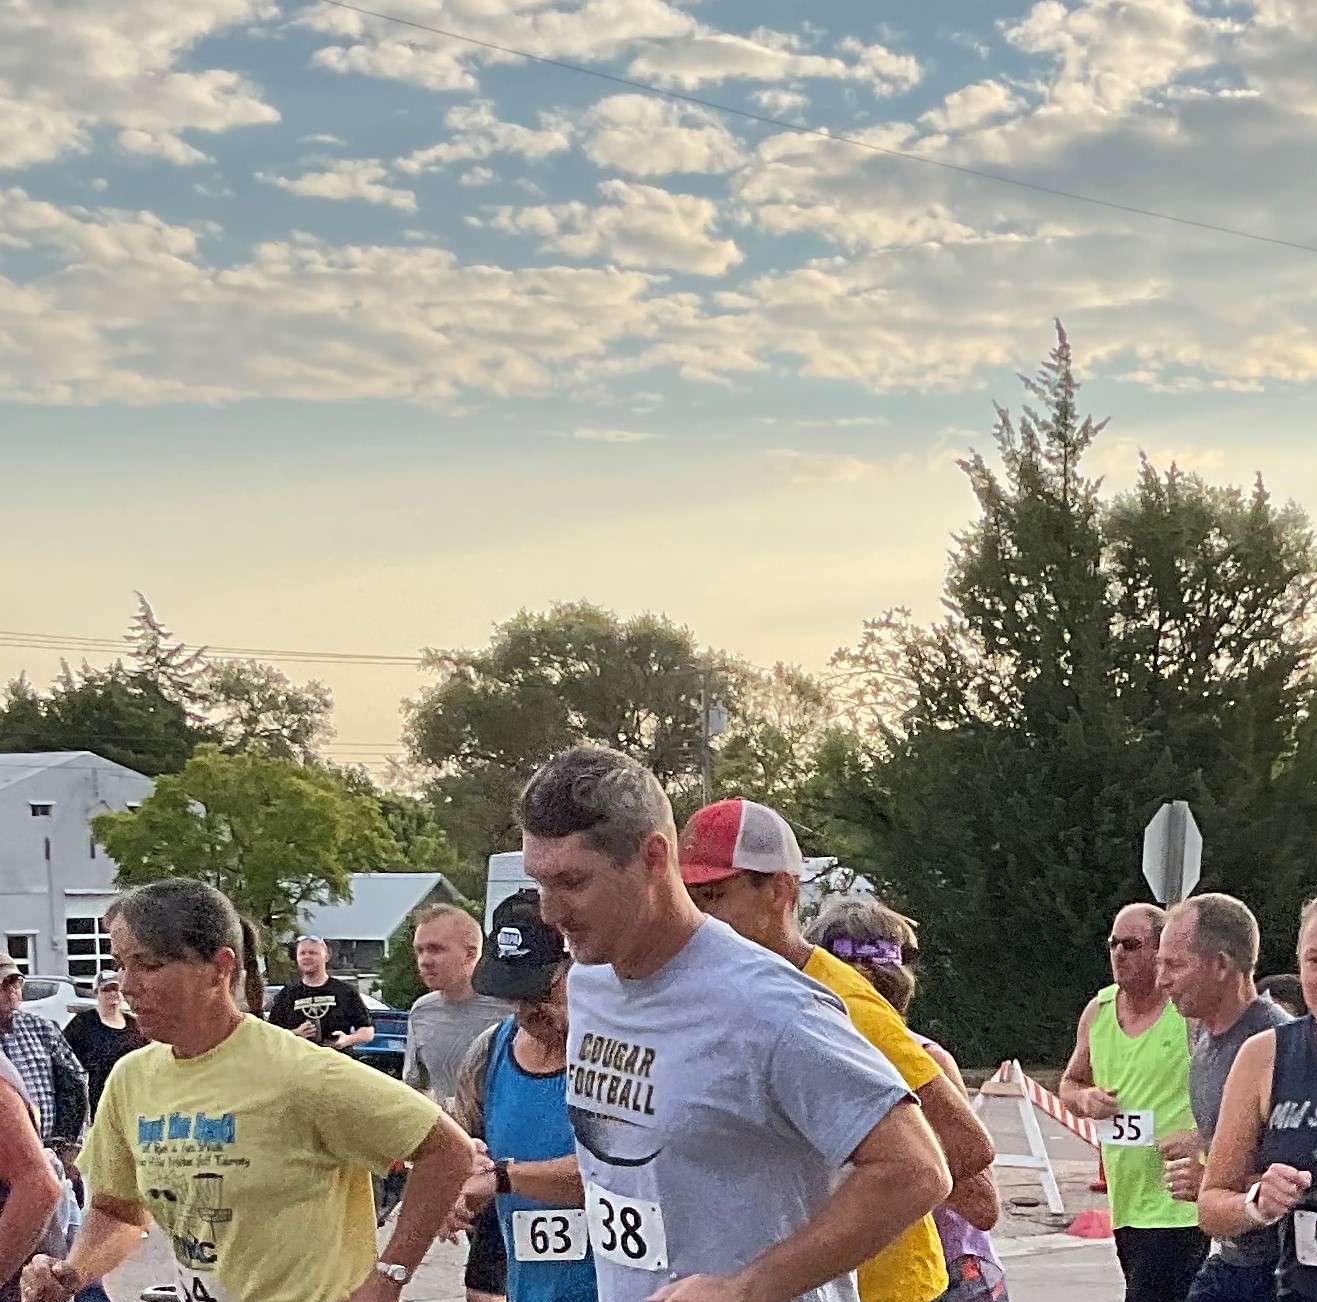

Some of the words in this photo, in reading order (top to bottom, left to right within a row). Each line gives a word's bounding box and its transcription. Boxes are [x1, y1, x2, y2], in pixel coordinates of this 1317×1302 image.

[579, 1032, 656, 1078] COUGAR
[1112, 1114, 1141, 1141] 55
[530, 1215, 572, 1255] 63
[599, 1197, 648, 1260] 38
